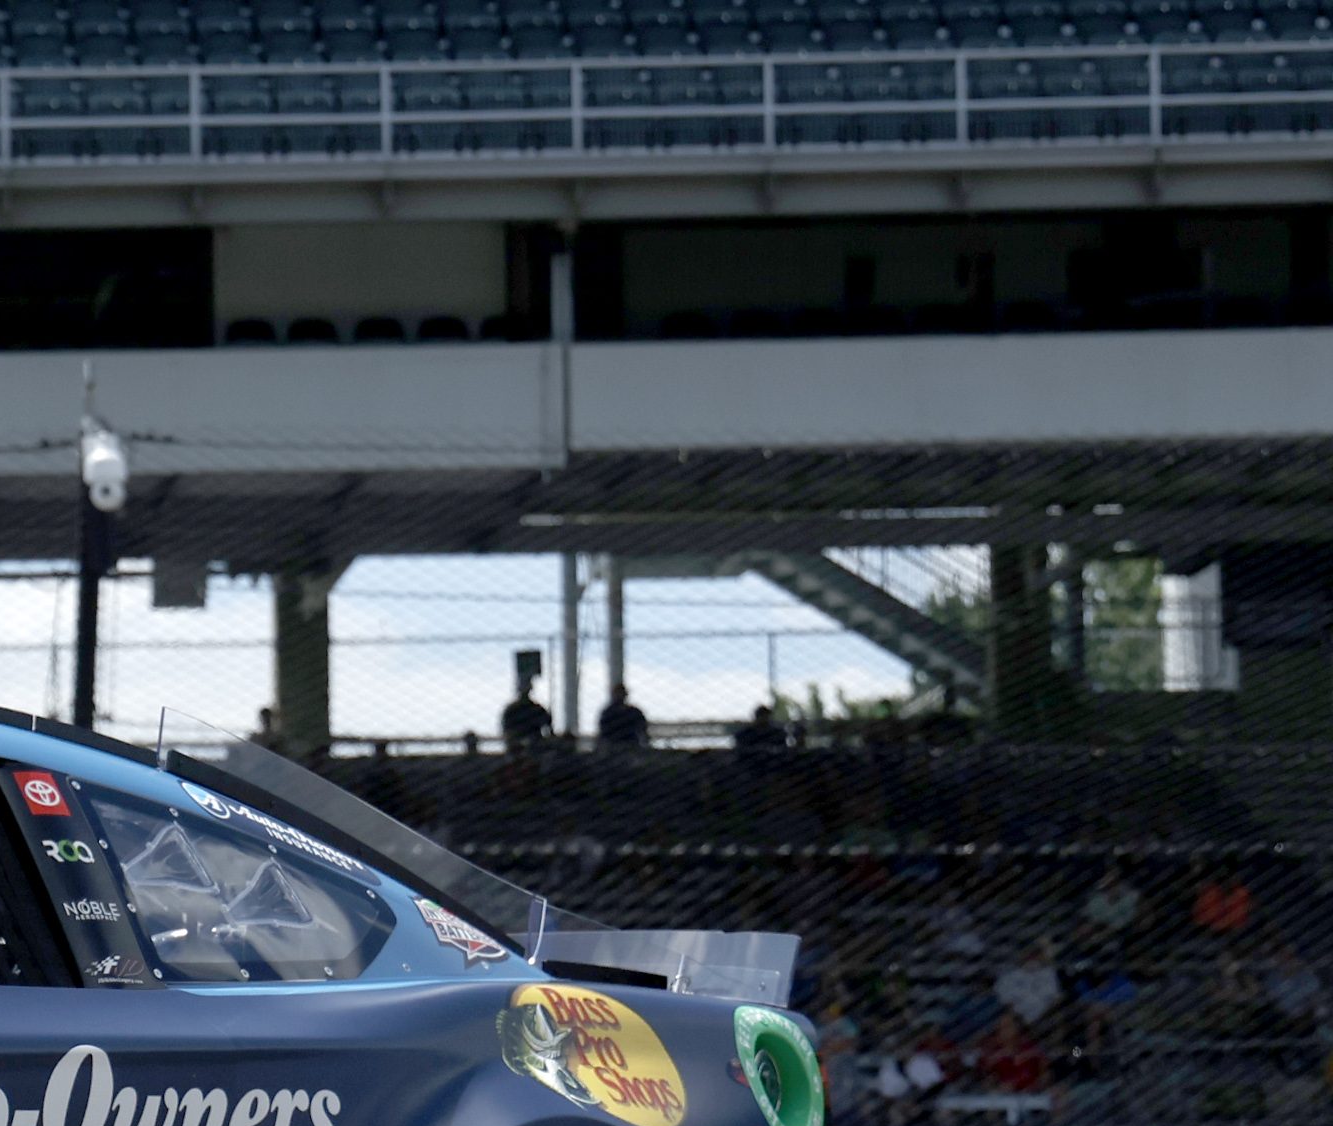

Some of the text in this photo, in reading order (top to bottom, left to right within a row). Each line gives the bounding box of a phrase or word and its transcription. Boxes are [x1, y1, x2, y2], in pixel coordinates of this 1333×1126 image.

[538, 987, 620, 1028] Bass
[570, 1027, 628, 1068] Pro
[594, 1066, 683, 1122] Shops
